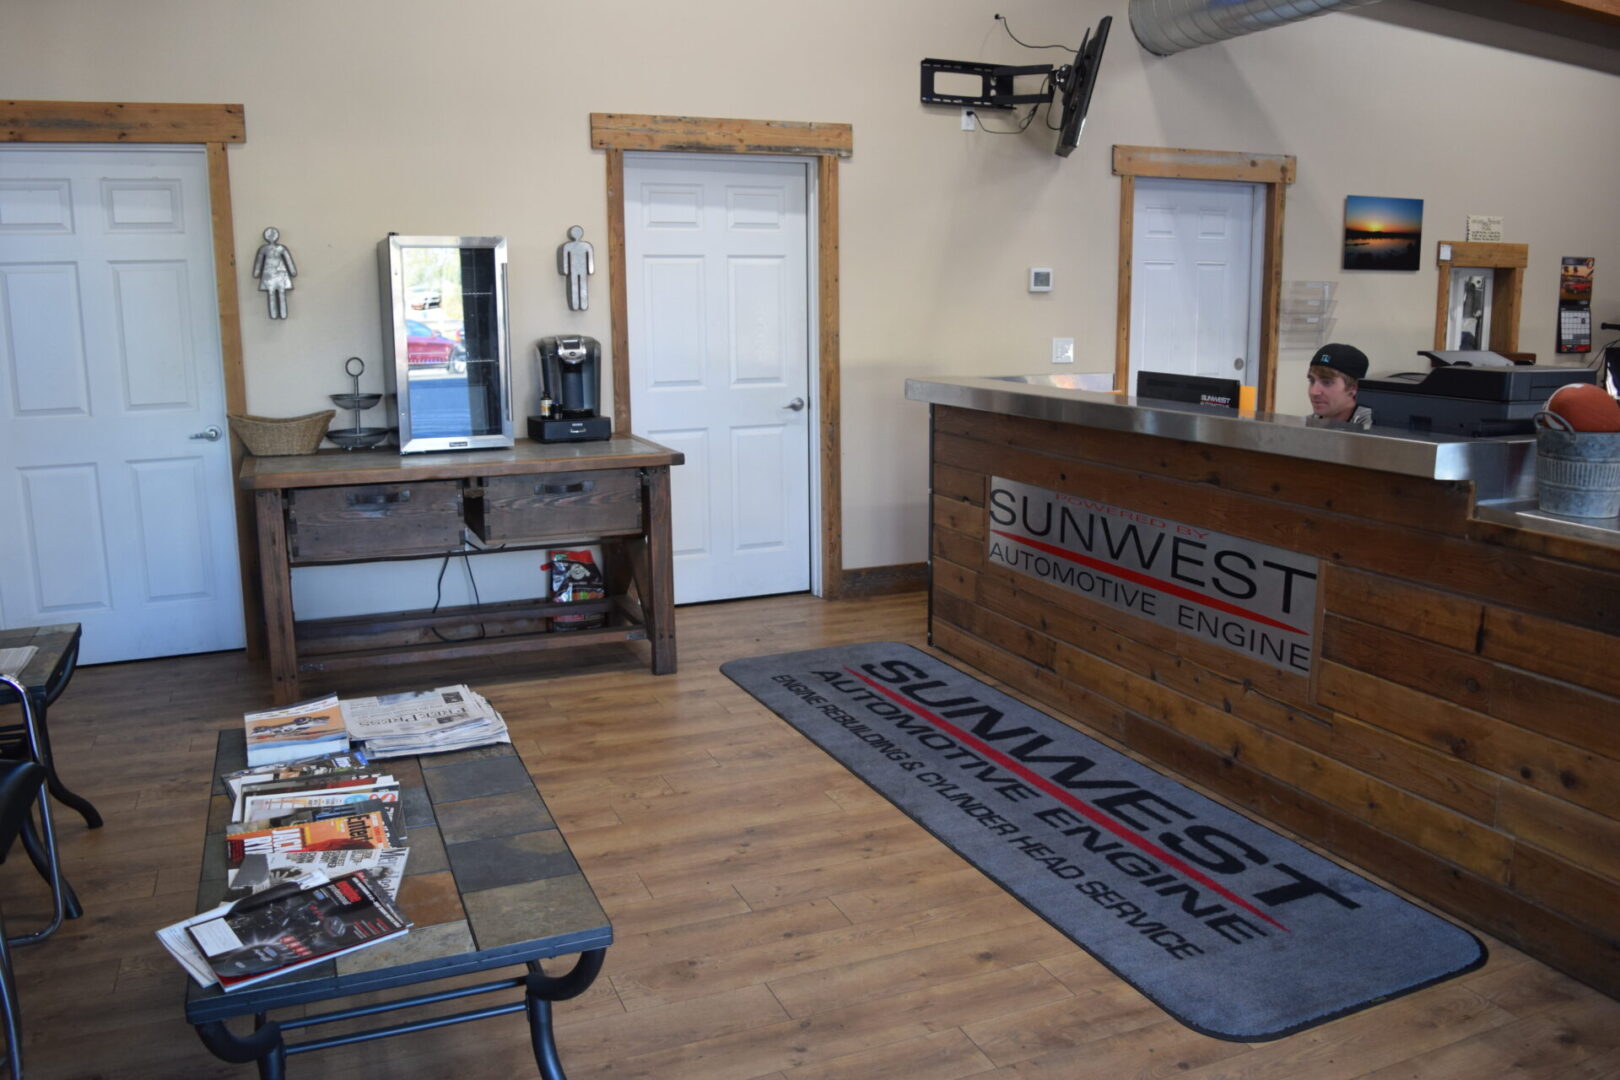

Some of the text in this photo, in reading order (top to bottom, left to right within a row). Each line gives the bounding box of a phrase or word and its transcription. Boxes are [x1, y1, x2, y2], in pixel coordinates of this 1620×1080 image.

[989, 489, 1317, 614] SUNWEST
[989, 542, 1310, 672] AUTOMOTIVE ENGINE
[1055, 493, 1209, 539] POWERED BY
[771, 674, 1204, 960] ENGINE REBUILDING & CYLINDER HEAD SERVICE
[812, 670, 1269, 944] AUTOMOTIVE ENGINE
[861, 660, 1362, 910] SUNWEST
